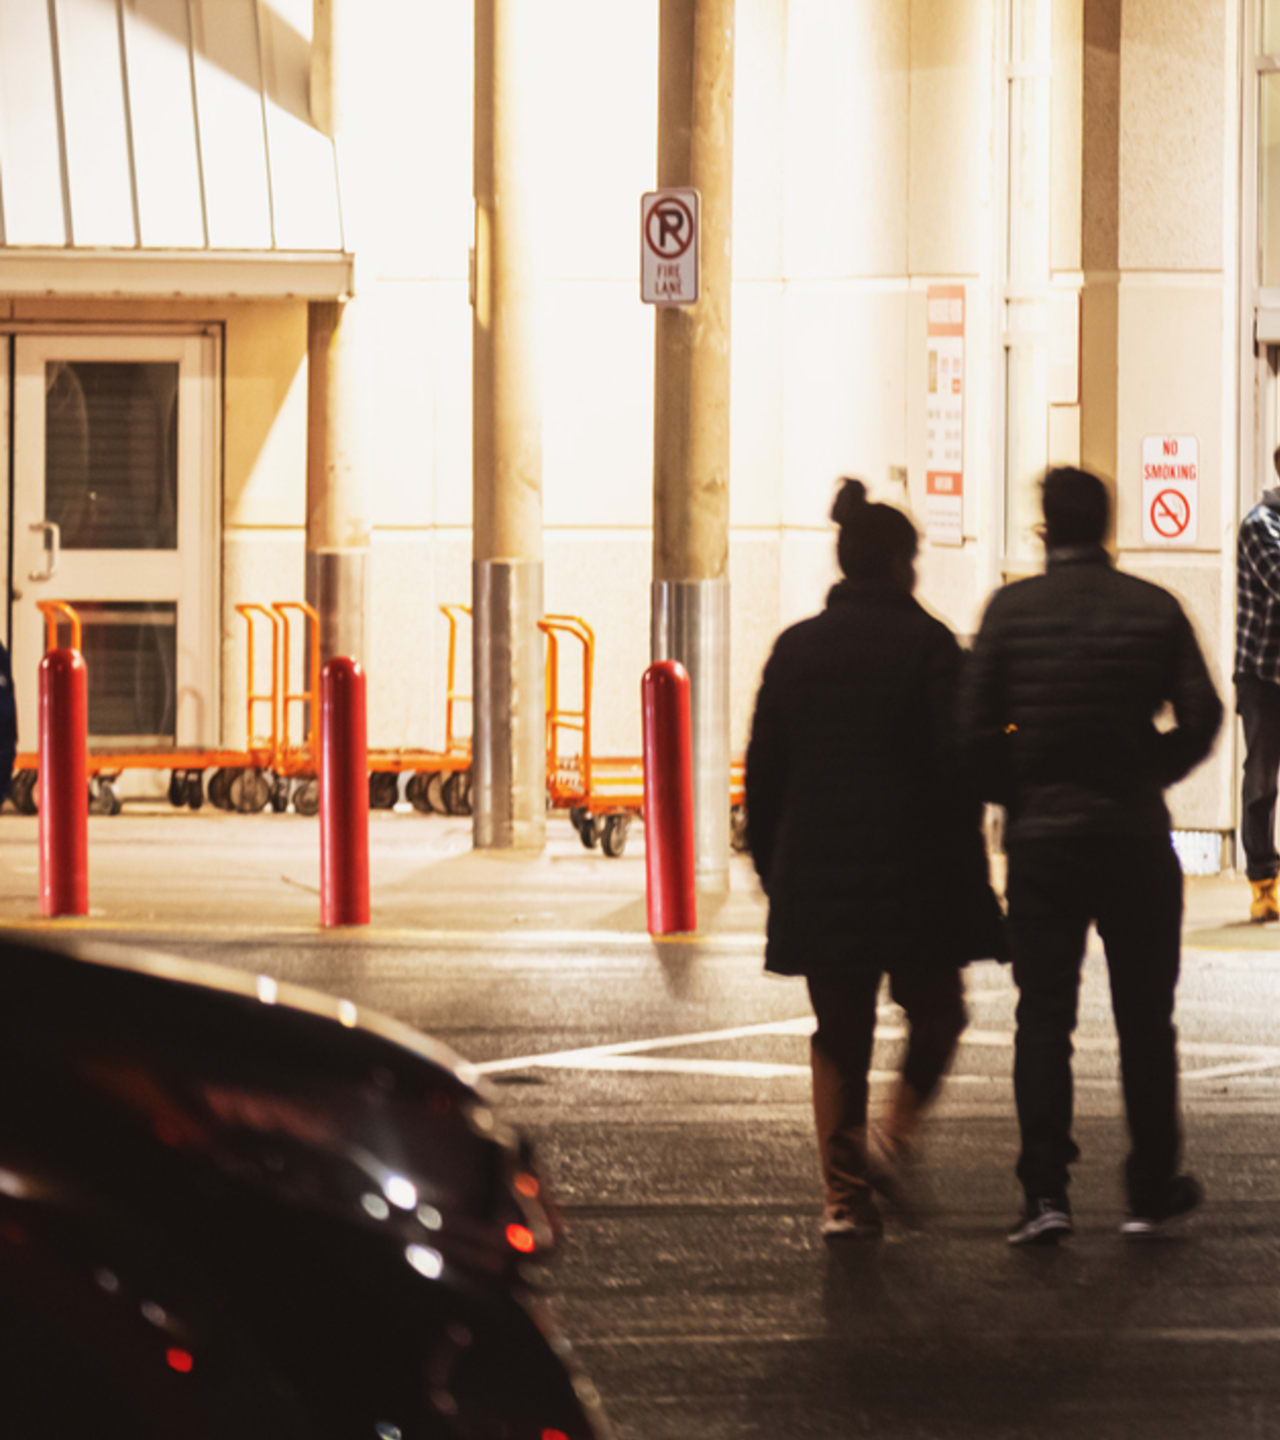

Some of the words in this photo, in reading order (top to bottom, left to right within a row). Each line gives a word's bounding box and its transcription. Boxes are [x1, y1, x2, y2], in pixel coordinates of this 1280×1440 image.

[657, 264, 681, 278] FIRE
[655, 282, 683, 296] LANE
[1162, 440, 1179, 457] NO
[1144, 463, 1197, 481] SMOKING
